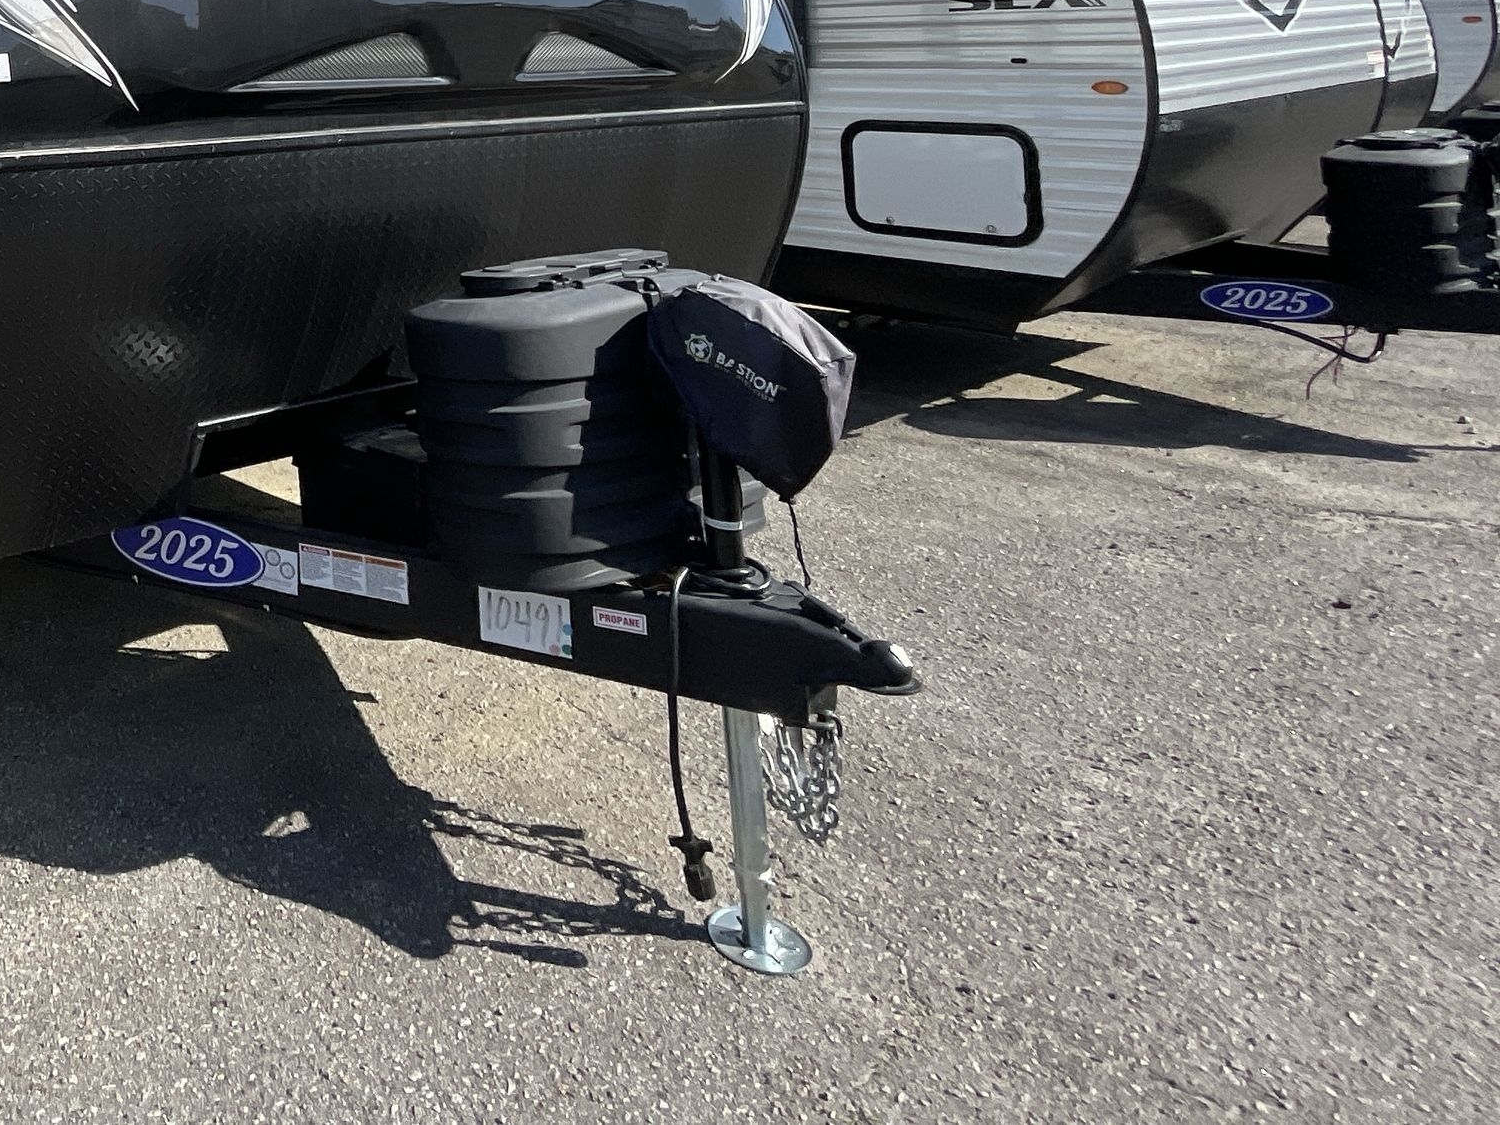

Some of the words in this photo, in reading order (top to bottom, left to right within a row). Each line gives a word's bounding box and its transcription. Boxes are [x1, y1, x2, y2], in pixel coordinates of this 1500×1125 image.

[1220, 287, 1311, 313] 2025
[134, 525, 239, 578] 2025
[487, 591, 563, 647] 10491
[599, 613, 640, 628] PROPANE
